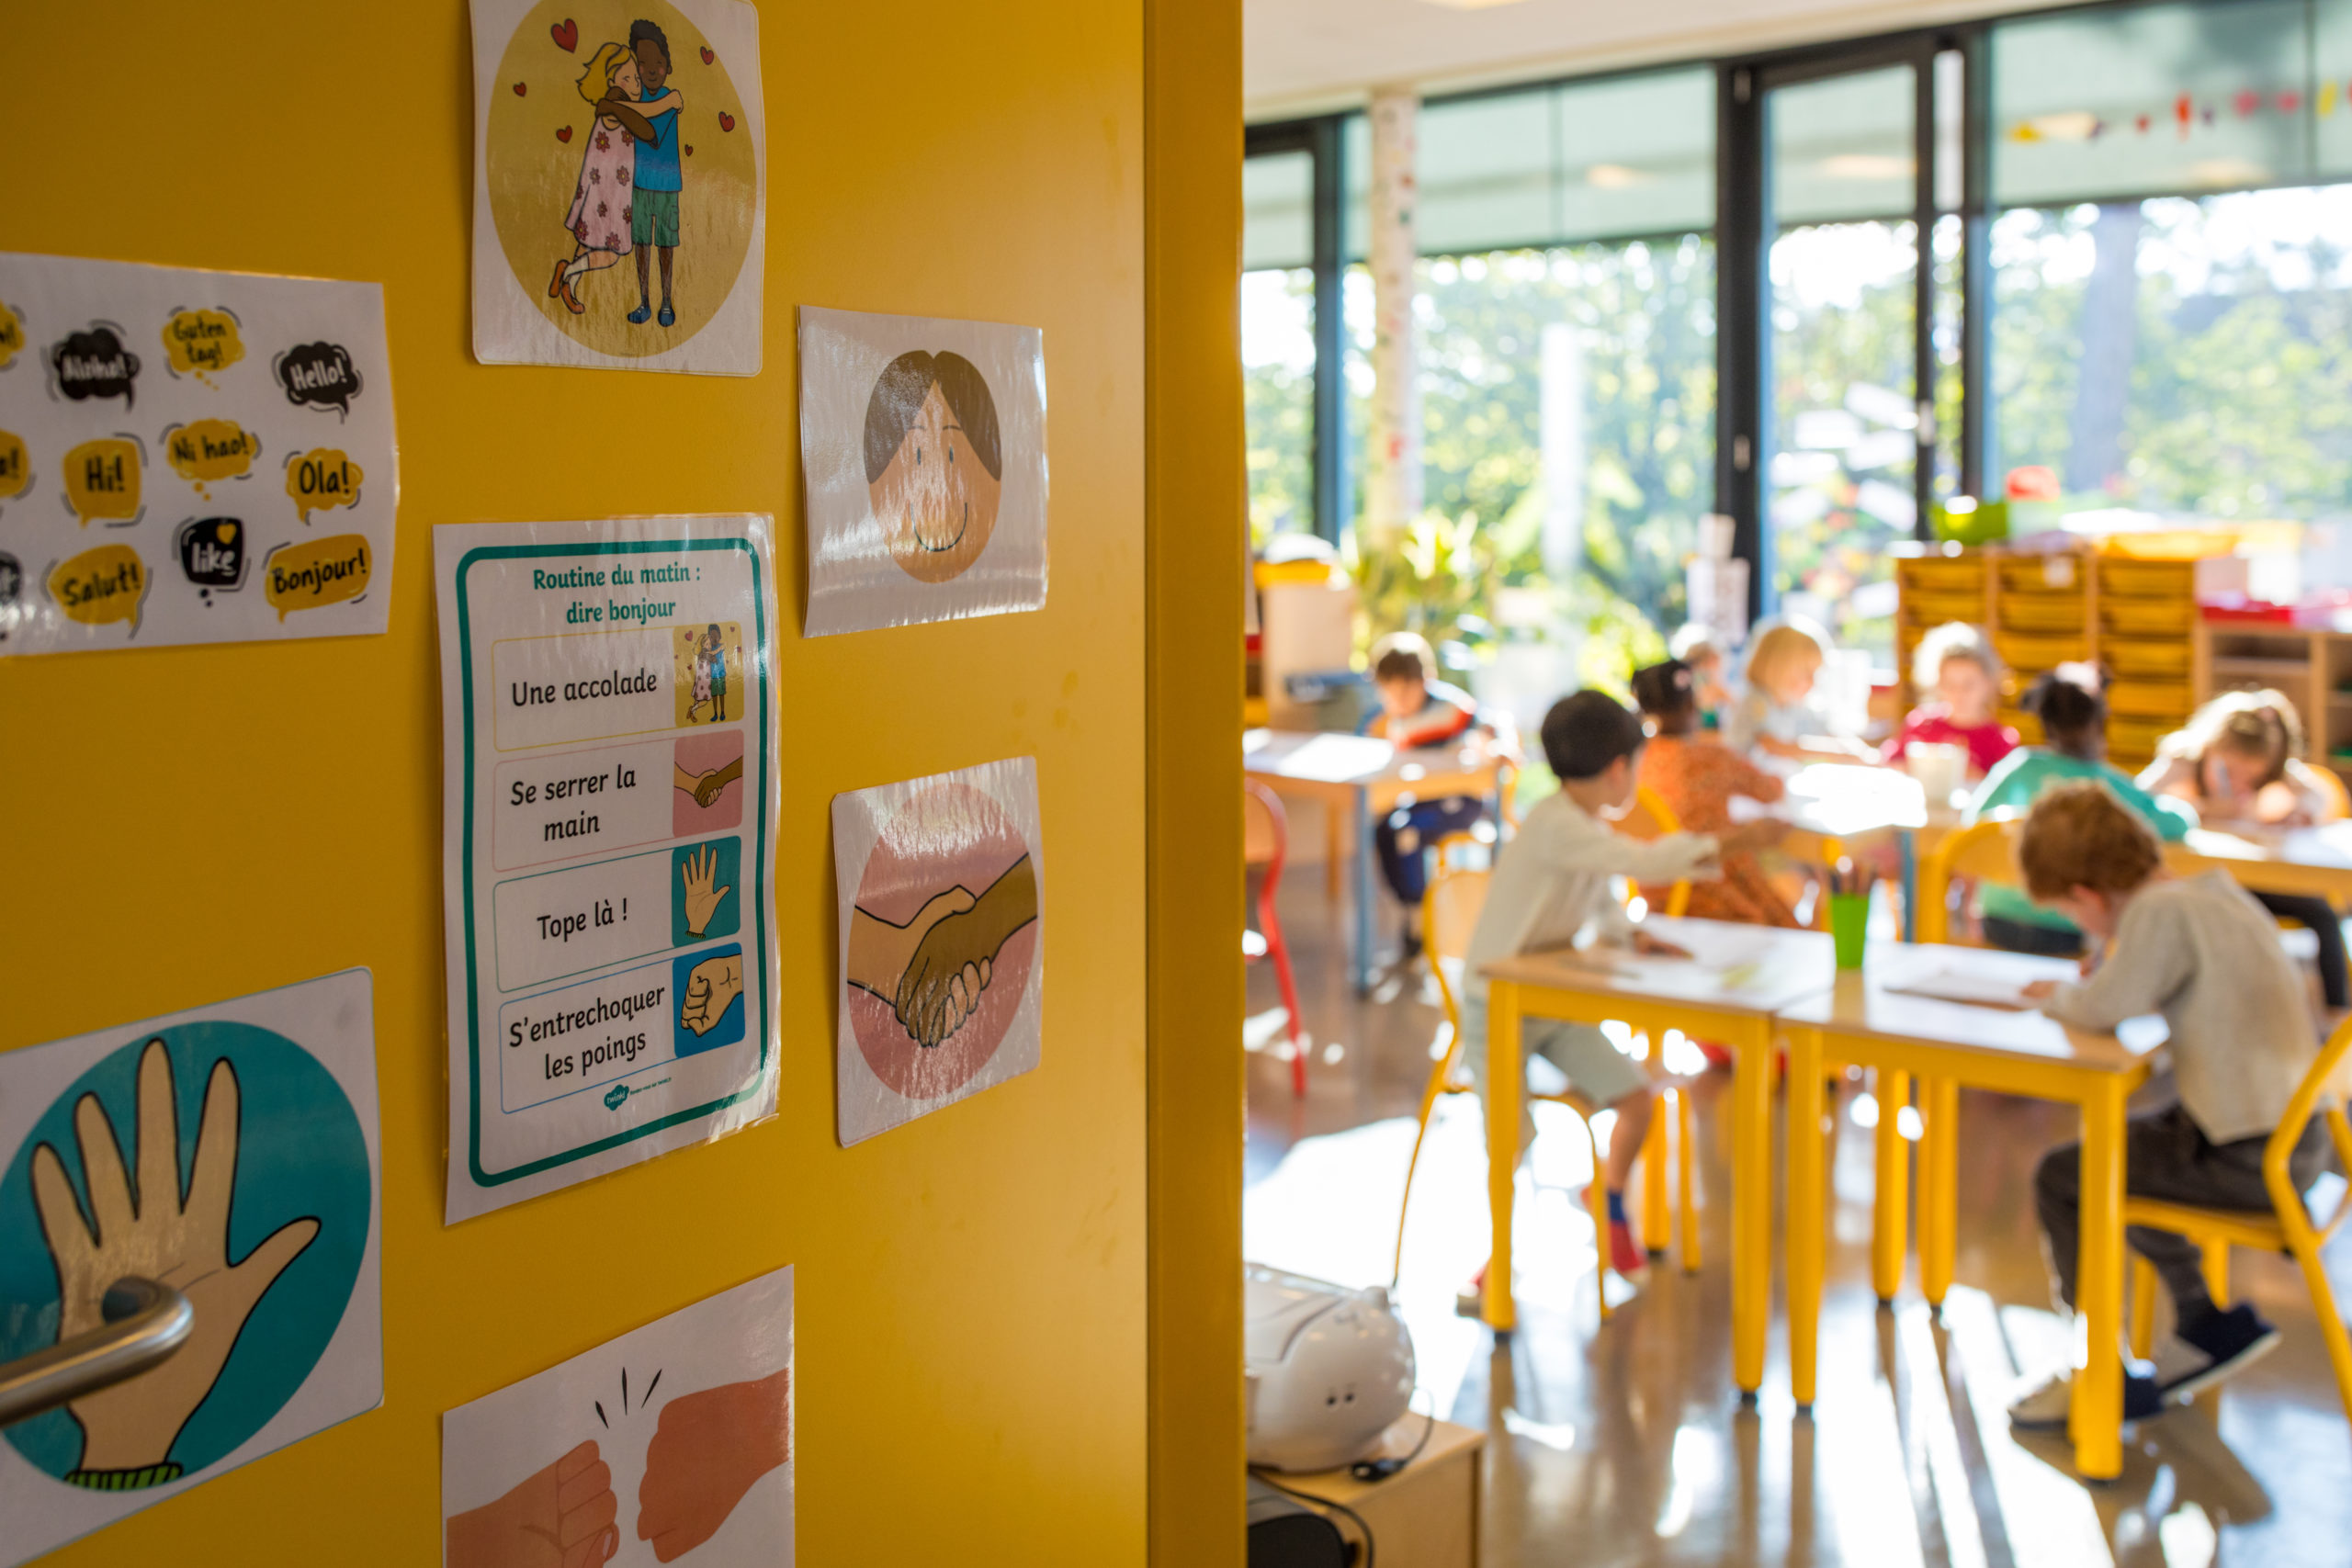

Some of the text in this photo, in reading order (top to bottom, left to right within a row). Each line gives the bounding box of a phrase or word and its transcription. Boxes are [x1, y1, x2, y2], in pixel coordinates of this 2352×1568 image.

[173, 316, 228, 343] Guten
[186, 342, 225, 368] tag!
[290, 362, 347, 390] Hello!
[173, 434, 250, 461] Ni hao!
[85, 456, 126, 493] Hi!
[299, 458, 350, 494] Ola!
[191, 543, 236, 574] like
[272, 547, 368, 595] Bonjour!
[533, 566, 606, 590] Routine
[611, 563, 635, 587] du
[640, 561, 691, 584] matin
[62, 562, 141, 607] Salut!
[566, 599, 677, 625] dire bonjour
[512, 668, 658, 707] Une accolade
[510, 764, 637, 807] Se serrer la
[544, 810, 601, 841] main
[537, 897, 628, 942] Tope là !
[509, 985, 665, 1048] S’entrechoquer
[545, 1032, 647, 1080] les poings
